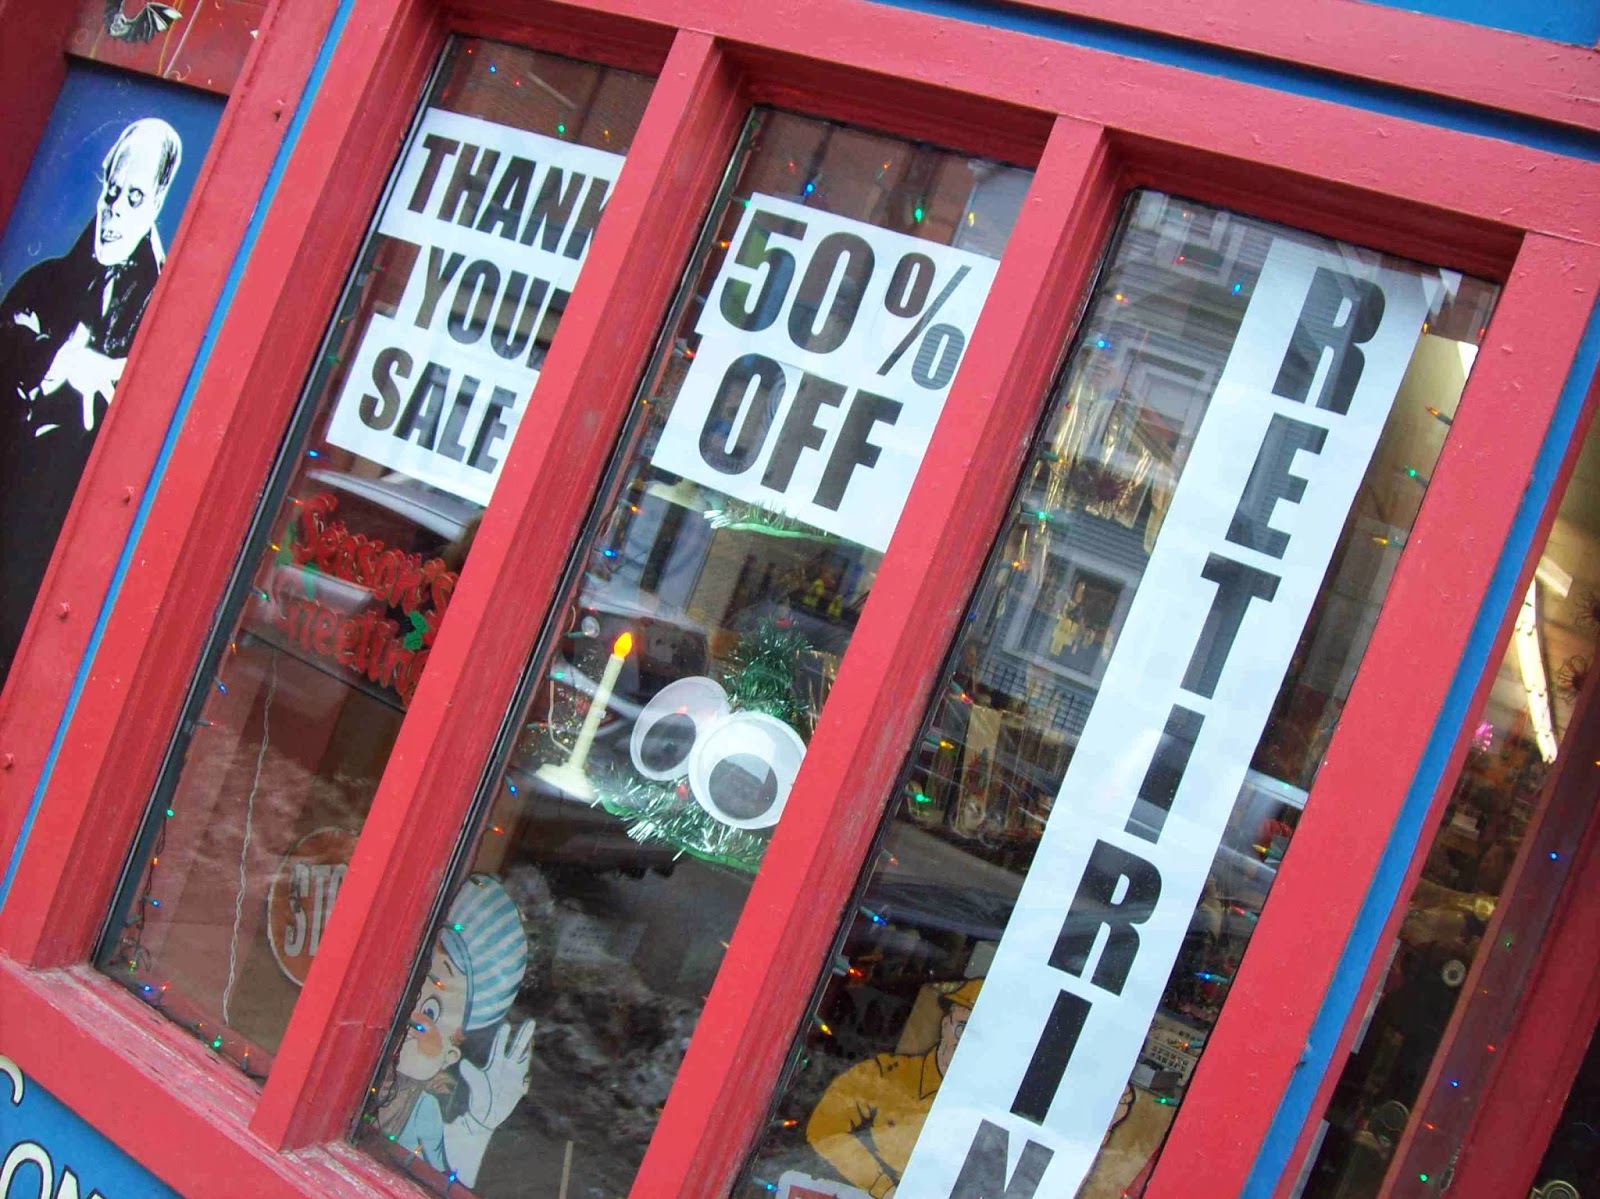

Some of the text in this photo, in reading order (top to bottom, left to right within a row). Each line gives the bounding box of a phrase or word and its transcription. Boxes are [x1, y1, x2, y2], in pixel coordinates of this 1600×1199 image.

[719, 209, 972, 390] 50%
[358, 347, 518, 474] SALE
[698, 353, 904, 511] OFF
